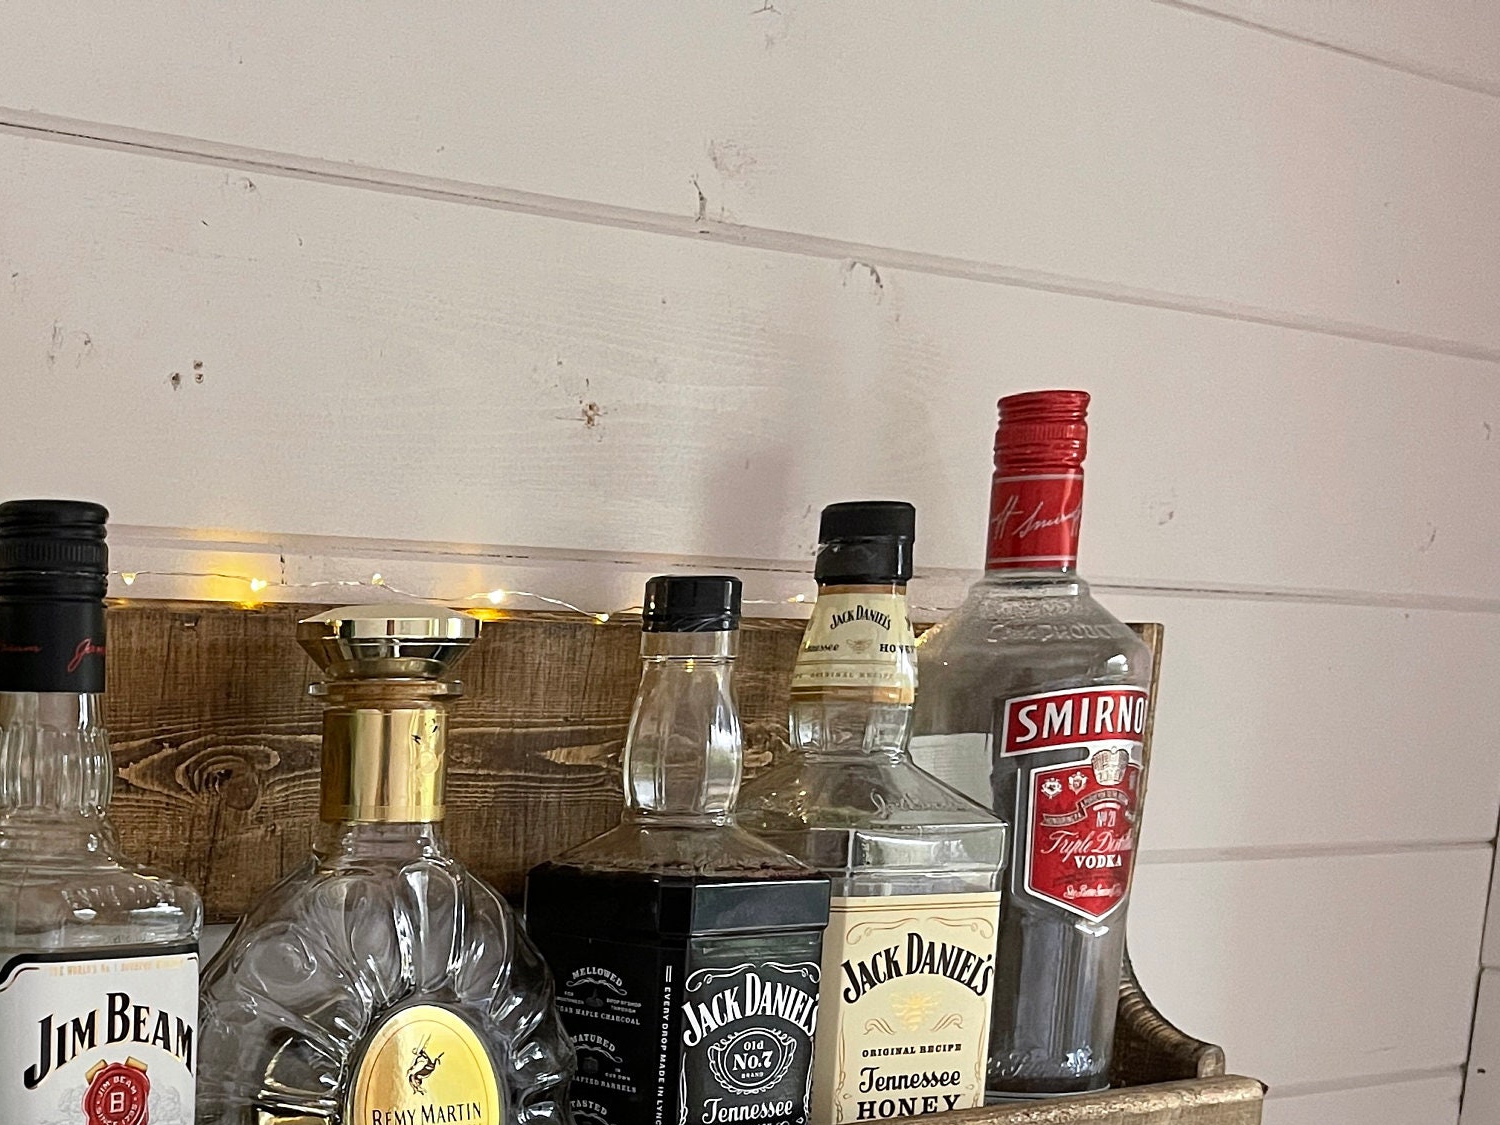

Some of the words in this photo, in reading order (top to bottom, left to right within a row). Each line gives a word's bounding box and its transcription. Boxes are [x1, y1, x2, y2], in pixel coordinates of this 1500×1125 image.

[829, 610, 855, 630] JACK
[855, 604, 892, 631] DANIEL'S
[1073, 853, 1123, 870] VODKA
[572, 966, 623, 988] MELLOWED
[841, 945, 905, 1005] JACK
[905, 932, 995, 998] DANIEL'S
[661, 986, 672, 1021] EVERY
[681, 985, 744, 1047] JACK
[744, 972, 820, 1037] DANIEL'S
[575, 1008, 599, 1019] MAPLE
[600, 1012, 641, 1026] CHARCOAL
[23, 1008, 99, 1091] JIM
[105, 991, 195, 1079] BEAM
[570, 1033, 616, 1053] MATURED
[659, 1023, 670, 1051] DROP
[743, 1040, 765, 1051] Old
[732, 1050, 774, 1072] No.7
[862, 1046, 916, 1058] ORIGINAL
[918, 1043, 962, 1055] RECIPE
[657, 1054, 668, 1084] MADE
[741, 1071, 765, 1079] BRAND
[858, 1065, 961, 1094] Tennessee
[98, 1080, 111, 1098] JIM
[112, 1075, 137, 1095] BEAM
[600, 1080, 637, 1094] BARRELS
[655, 1086, 666, 1098] IN
[110, 1091, 125, 1114] B
[421, 1102, 482, 1125] MARTIN
[570, 1099, 608, 1116] TASTED
[702, 1097, 794, 1125] Tennessee
[856, 1093, 961, 1121] HONEY
